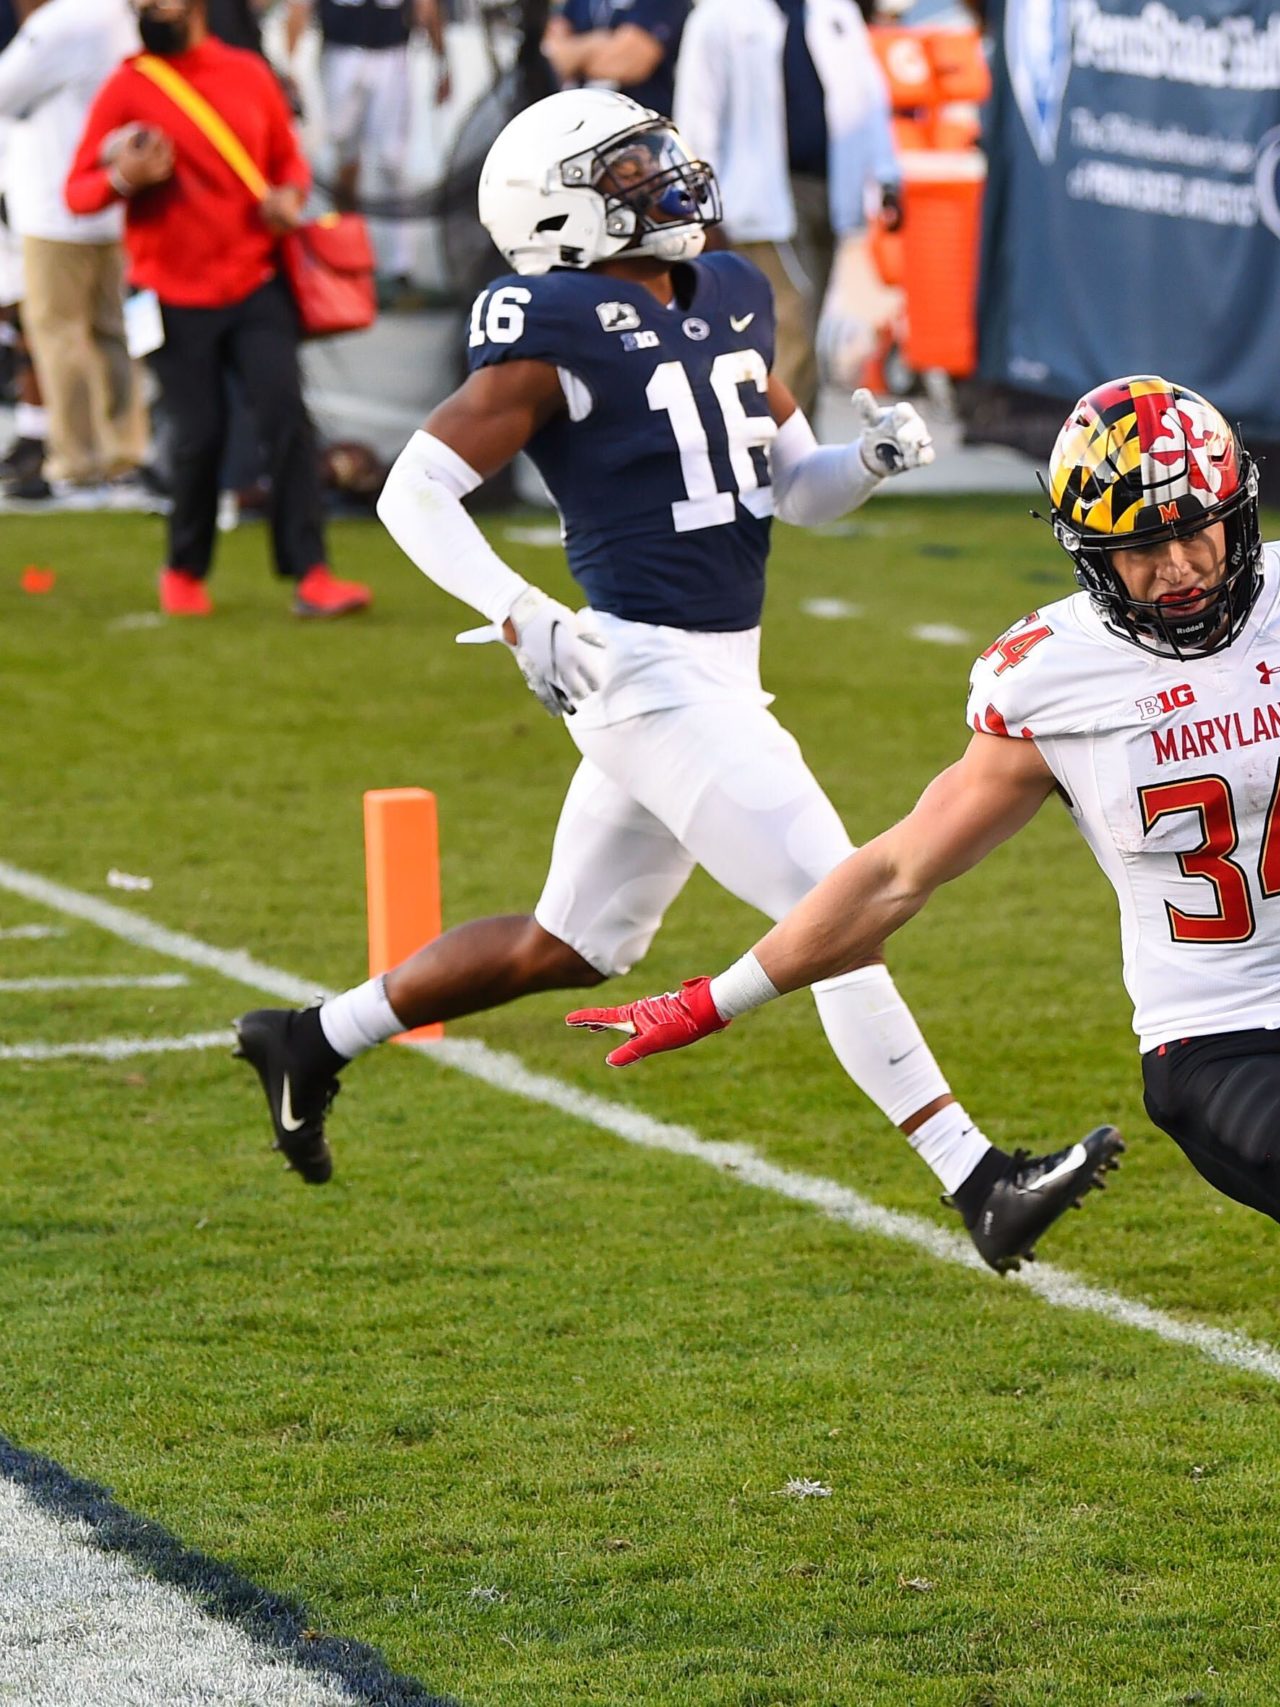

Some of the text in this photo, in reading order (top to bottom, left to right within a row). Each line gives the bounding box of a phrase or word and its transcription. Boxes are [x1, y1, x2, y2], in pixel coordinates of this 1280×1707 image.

[469, 286, 532, 348] 16
[645, 348, 777, 533] 16
[1157, 500, 1181, 525] M
